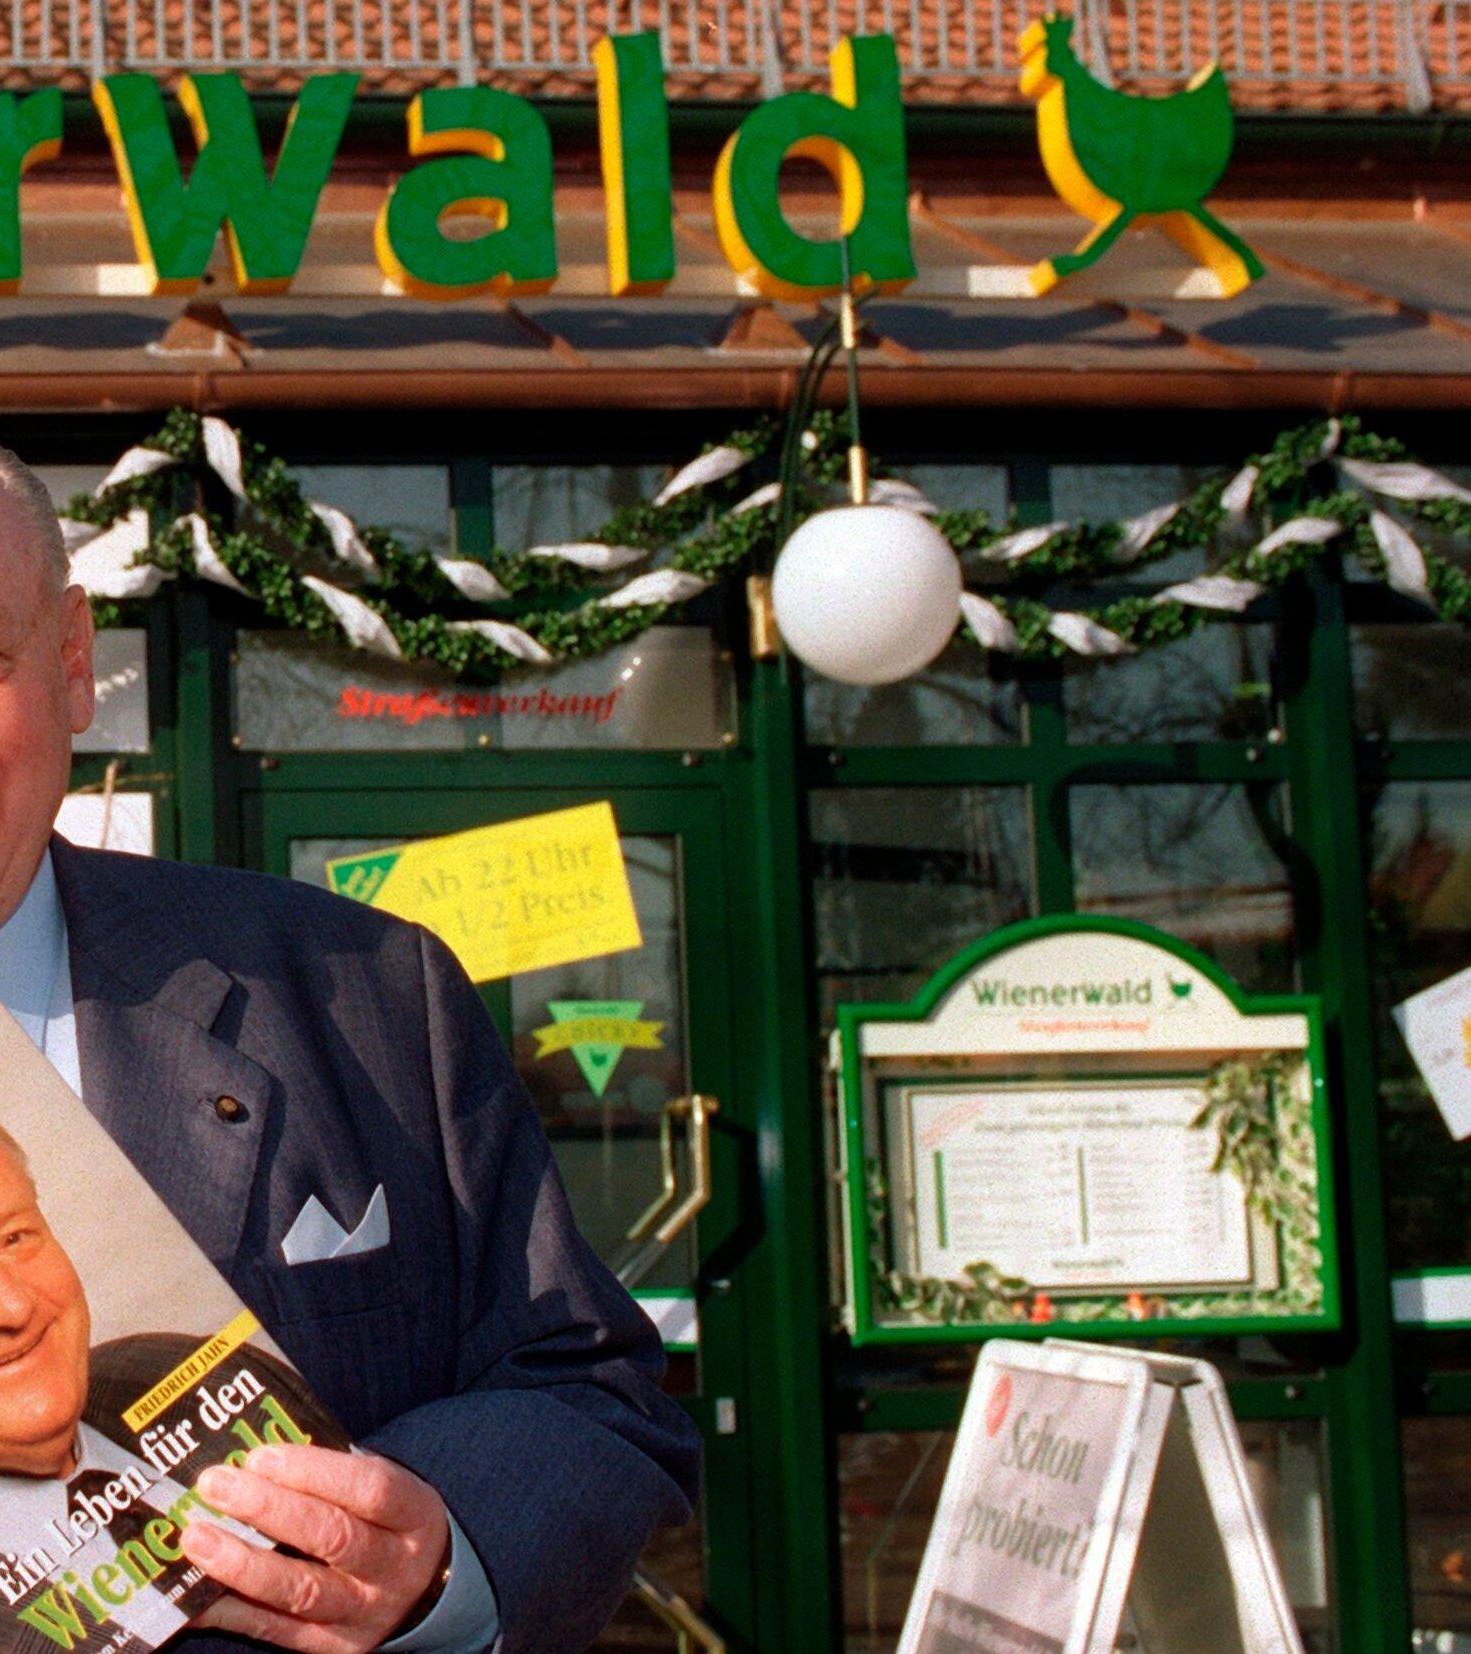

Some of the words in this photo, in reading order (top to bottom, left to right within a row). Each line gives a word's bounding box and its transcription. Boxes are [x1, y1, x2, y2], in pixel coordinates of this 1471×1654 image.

[418, 867, 462, 904] Ab
[472, 853, 519, 890] 22
[525, 842, 593, 880] Uhr
[519, 884, 607, 922] Preis
[971, 978, 1153, 1007] Wienerwald
[133, 1362, 200, 1422] FRIEDRICH
[198, 1336, 230, 1371] JAHN
[44, 1464, 154, 1557] Leben
[137, 1424, 200, 1476] für
[197, 1368, 266, 1431] den
[1000, 1410, 1089, 1486] Schon
